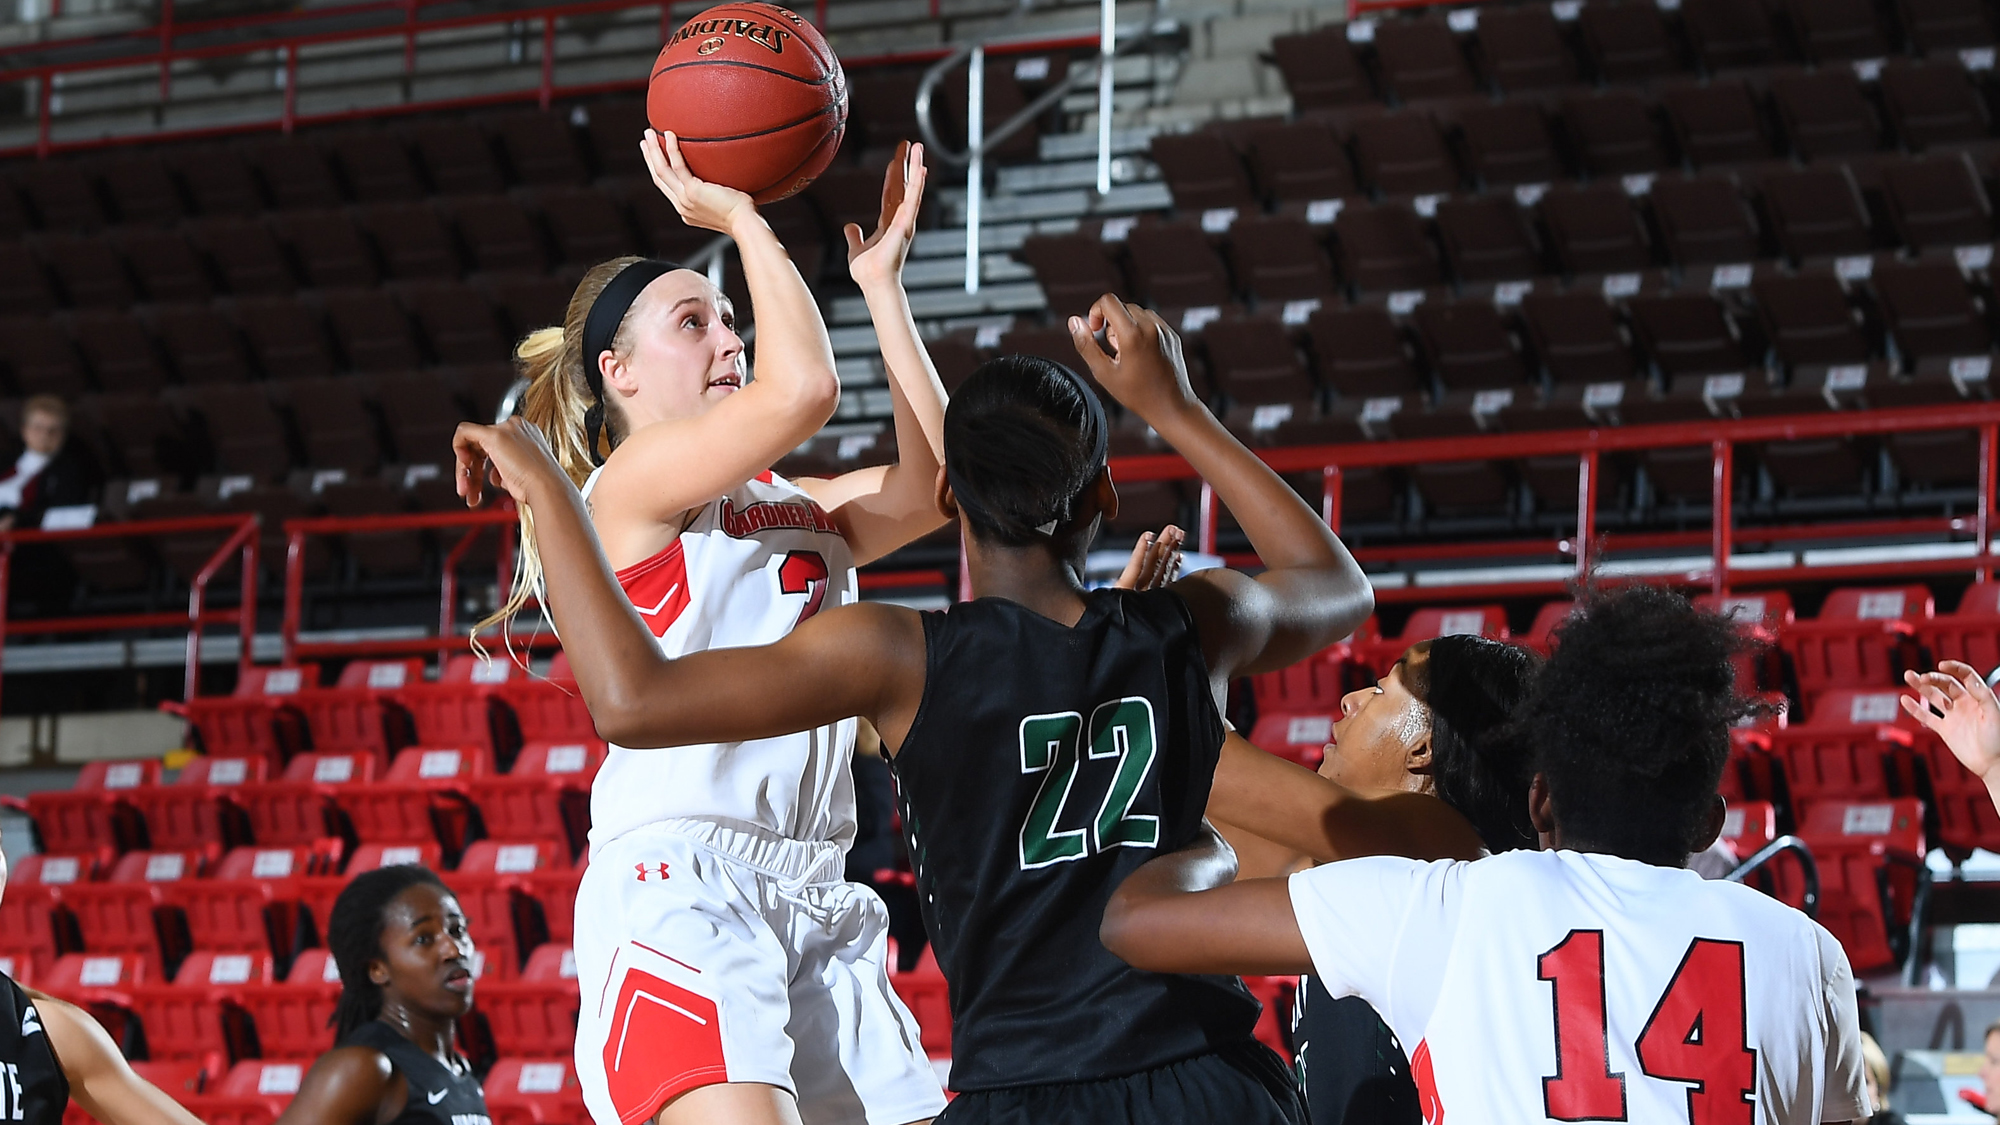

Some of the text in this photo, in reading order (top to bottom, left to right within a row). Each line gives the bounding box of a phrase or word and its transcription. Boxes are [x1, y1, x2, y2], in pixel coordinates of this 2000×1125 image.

[661, 18, 791, 56] SPALDIN
[1019, 696, 1160, 871] 22
[1537, 929, 1757, 1125] 14
